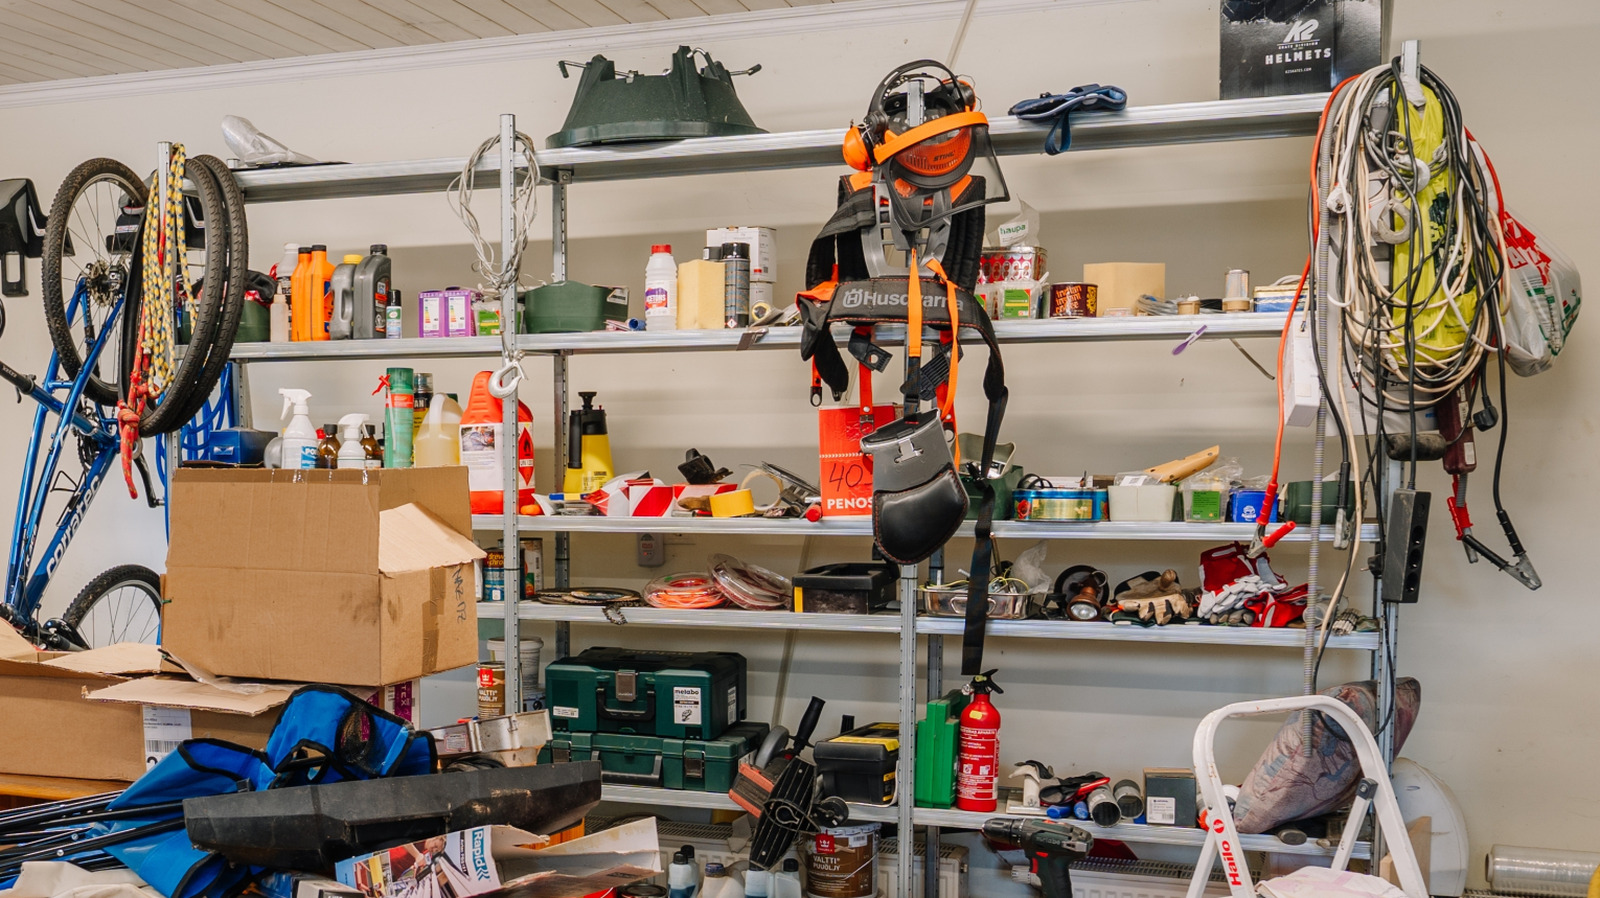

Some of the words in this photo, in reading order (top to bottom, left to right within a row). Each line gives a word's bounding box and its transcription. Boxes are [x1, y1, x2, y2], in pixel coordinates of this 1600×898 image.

[1282, 19, 1319, 43] K2
[1265, 47, 1332, 65] HELMETS
[933, 151, 955, 161] STIHL
[1000, 224, 1026, 235] haupa
[827, 497, 873, 509] PENOS
[46, 475, 101, 580] corratec
[474, 830, 485, 867] Rapid
[813, 855, 837, 864] VALTTI
[813, 863, 840, 871] PUUÖLJY
[1222, 840, 1242, 886] Hailo
